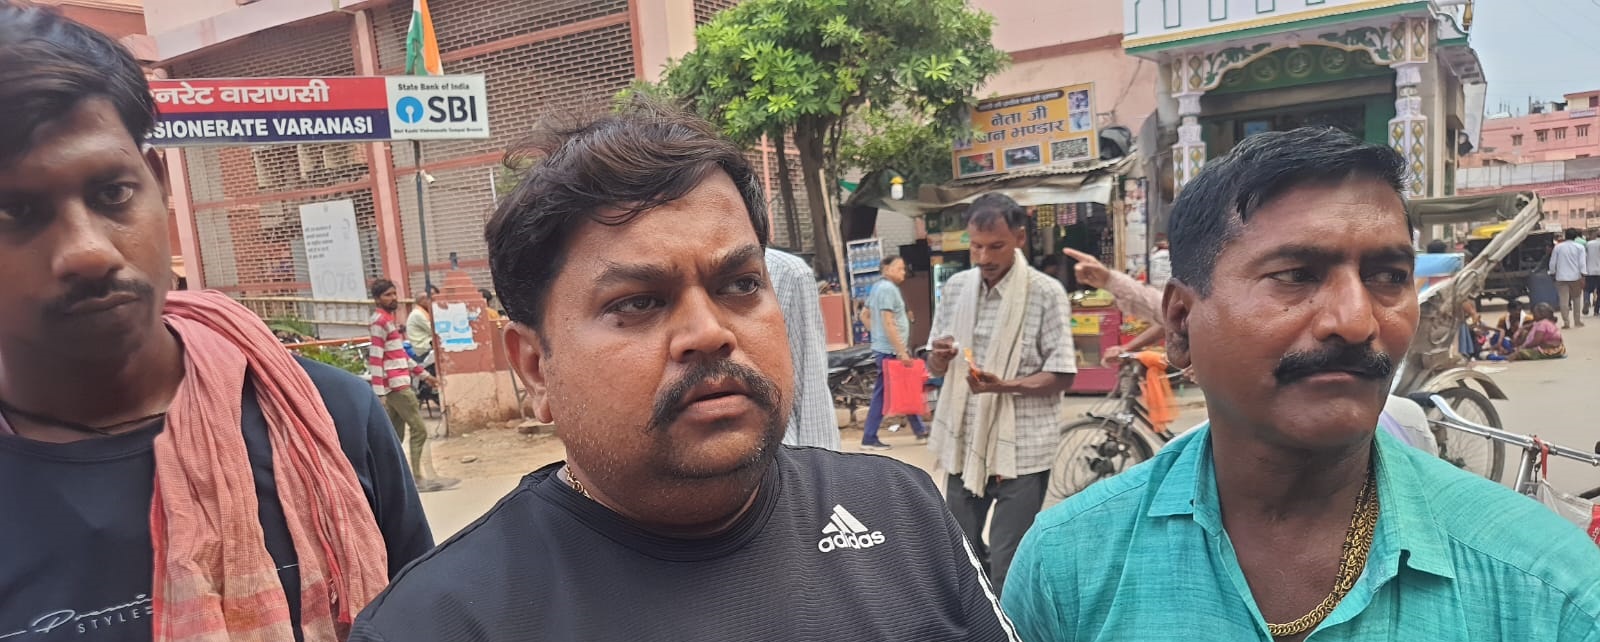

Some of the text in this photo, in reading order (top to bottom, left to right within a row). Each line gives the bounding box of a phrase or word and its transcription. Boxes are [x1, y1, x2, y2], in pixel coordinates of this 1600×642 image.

[151, 79, 330, 105] नरेट वाराणसी
[398, 83, 418, 91] State
[428, 95, 478, 123] SBI
[991, 105, 1047, 127] नेता जी
[272, 115, 373, 136] VARANASI
[1011, 120, 1065, 138] भण्डार
[818, 531, 886, 553] adidas
